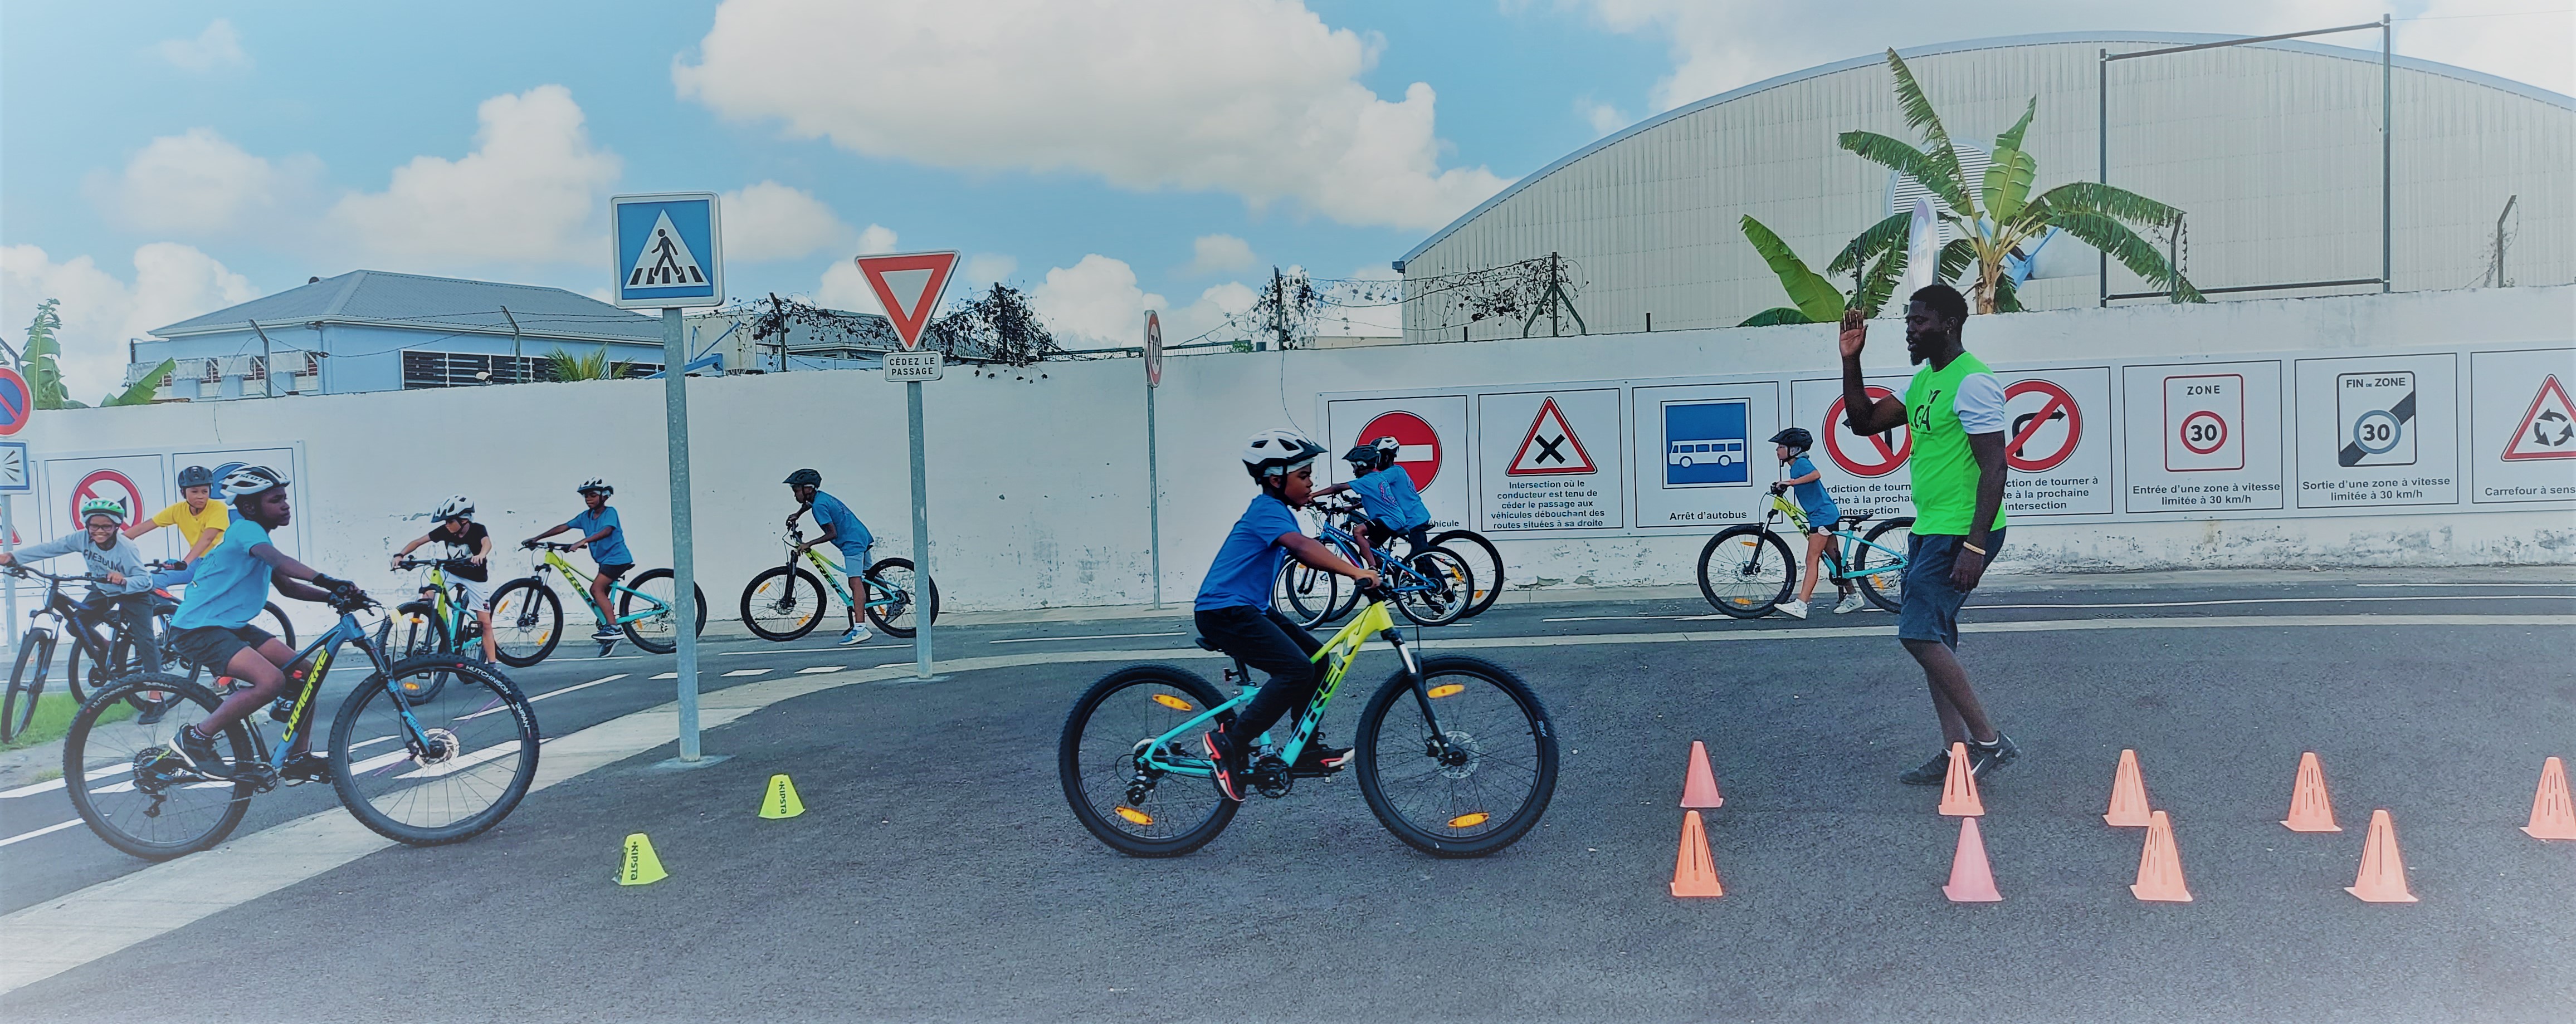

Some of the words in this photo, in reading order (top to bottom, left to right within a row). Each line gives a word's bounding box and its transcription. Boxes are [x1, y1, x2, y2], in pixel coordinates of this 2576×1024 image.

[1151, 334, 1159, 365] 70
[890, 356, 919, 366] CÉDEZ
[2346, 379, 2363, 388] FIN
[2374, 378, 2406, 387] ZONE
[2187, 385, 2220, 395] ZONE
[2190, 424, 2217, 442] 30
[2363, 424, 2390, 441] 30
[240, 473, 271, 484] SCOTT
[2035, 478, 2047, 486] de
[2051, 477, 2089, 486] tourner
[2092, 476, 2098, 484] à
[2302, 480, 2335, 490] Sortie
[2338, 480, 2368, 488] d'une
[2372, 479, 2398, 488] zone
[2402, 478, 2408, 486] à
[2411, 477, 2450, 486] vitesse
[1827, 484, 1865, 493] rdiction
[2016, 490, 2021, 498] à
[2037, 488, 2089, 499] prochaine
[2133, 485, 2167, 494] Entrée
[2170, 484, 2200, 493] d'une
[2232, 483, 2238, 492] à
[2242, 483, 2280, 491] vitesse
[2485, 487, 2538, 496] Carrefour
[2540, 486, 2546, 494] à
[2550, 486, 2576, 494] sens
[1833, 496, 1851, 504] che
[1853, 496, 1860, 504] à
[1875, 494, 1913, 505] prochai
[2162, 496, 2197, 505] limitée
[2201, 496, 2206, 504] à
[2226, 494, 2251, 503] km/h
[2331, 491, 2367, 501] limitée
[2370, 491, 2377, 499] à
[2380, 491, 2393, 499] 30
[2396, 489, 2423, 499] km/h
[1840, 506, 1900, 515] intersection
[2005, 501, 2067, 510] intersection
[1491, 511, 1532, 519] véhicules
[1670, 512, 1695, 521] Arrêt
[1697, 511, 1747, 520] d'autobus
[1523, 520, 1554, 528] situées
[809, 551, 843, 594] TREK
[466, 665, 510, 694] HUTCHINSON
[1290, 636, 1357, 743] TREK
[282, 649, 328, 742] LAPIERRE
